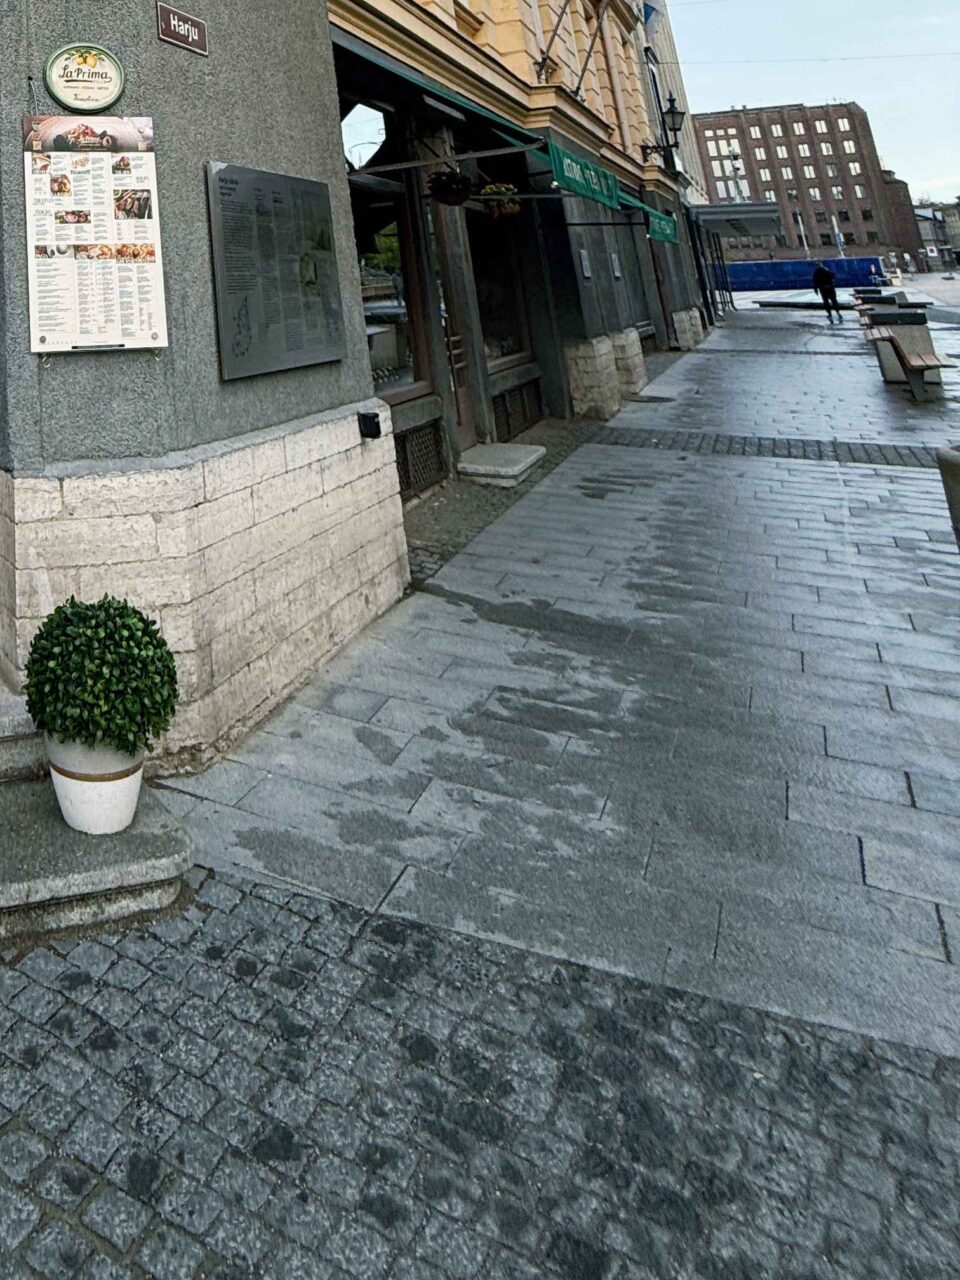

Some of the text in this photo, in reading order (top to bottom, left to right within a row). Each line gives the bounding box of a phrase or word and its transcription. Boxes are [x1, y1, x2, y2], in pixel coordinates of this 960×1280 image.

[170, 13, 198, 42] Harju
[58, 64, 112, 83] La Prima
